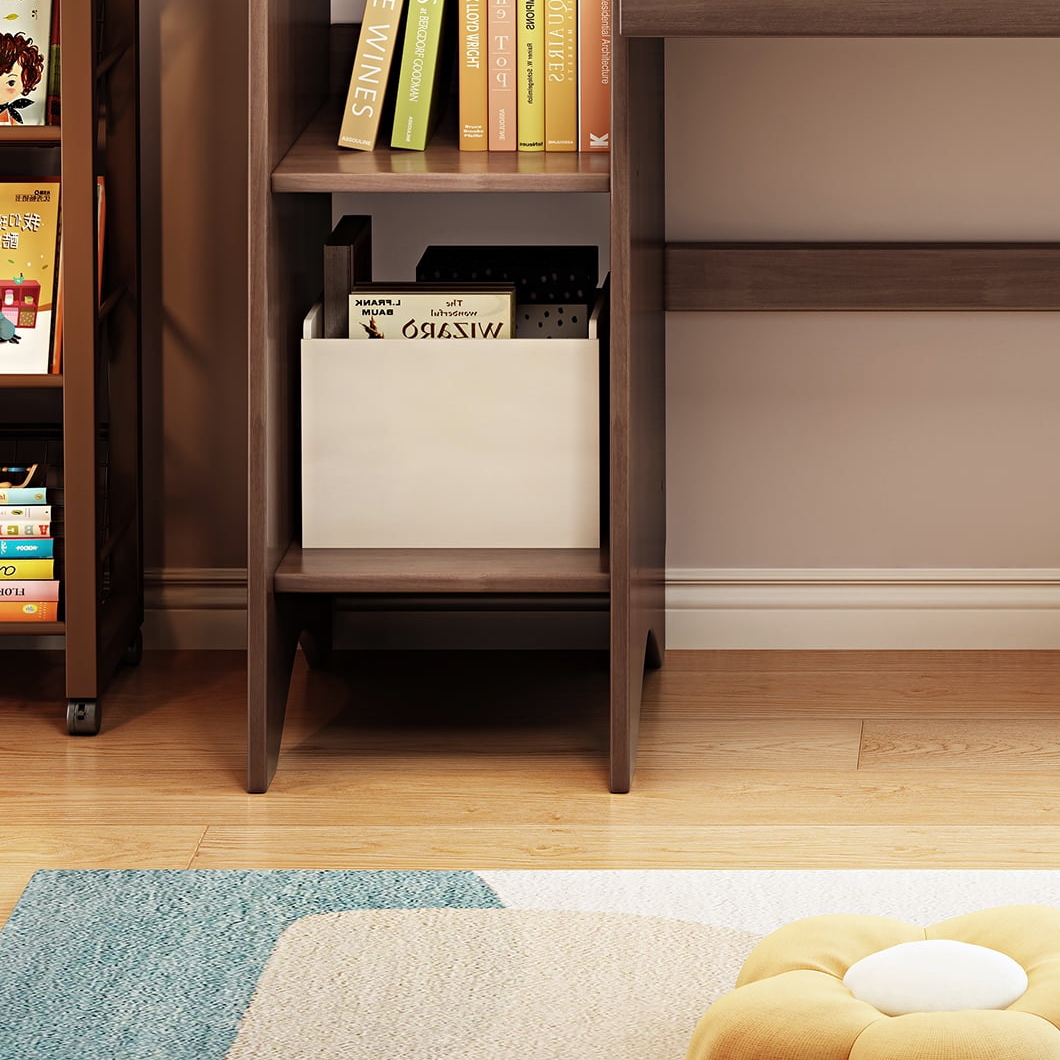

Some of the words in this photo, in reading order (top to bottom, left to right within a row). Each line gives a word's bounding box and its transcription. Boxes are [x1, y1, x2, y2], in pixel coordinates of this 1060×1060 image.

[419, 7, 428, 15] at
[466, 4, 480, 33] LLOYD
[414, 15, 428, 58] BERGDORF
[466, 35, 480, 69] WRIGHT
[351, 23, 391, 119] WINES
[408, 58, 424, 102] GOODMAN
[600, 39, 610, 84] Architecture
[341, 135, 373, 147] ASSOULINE
